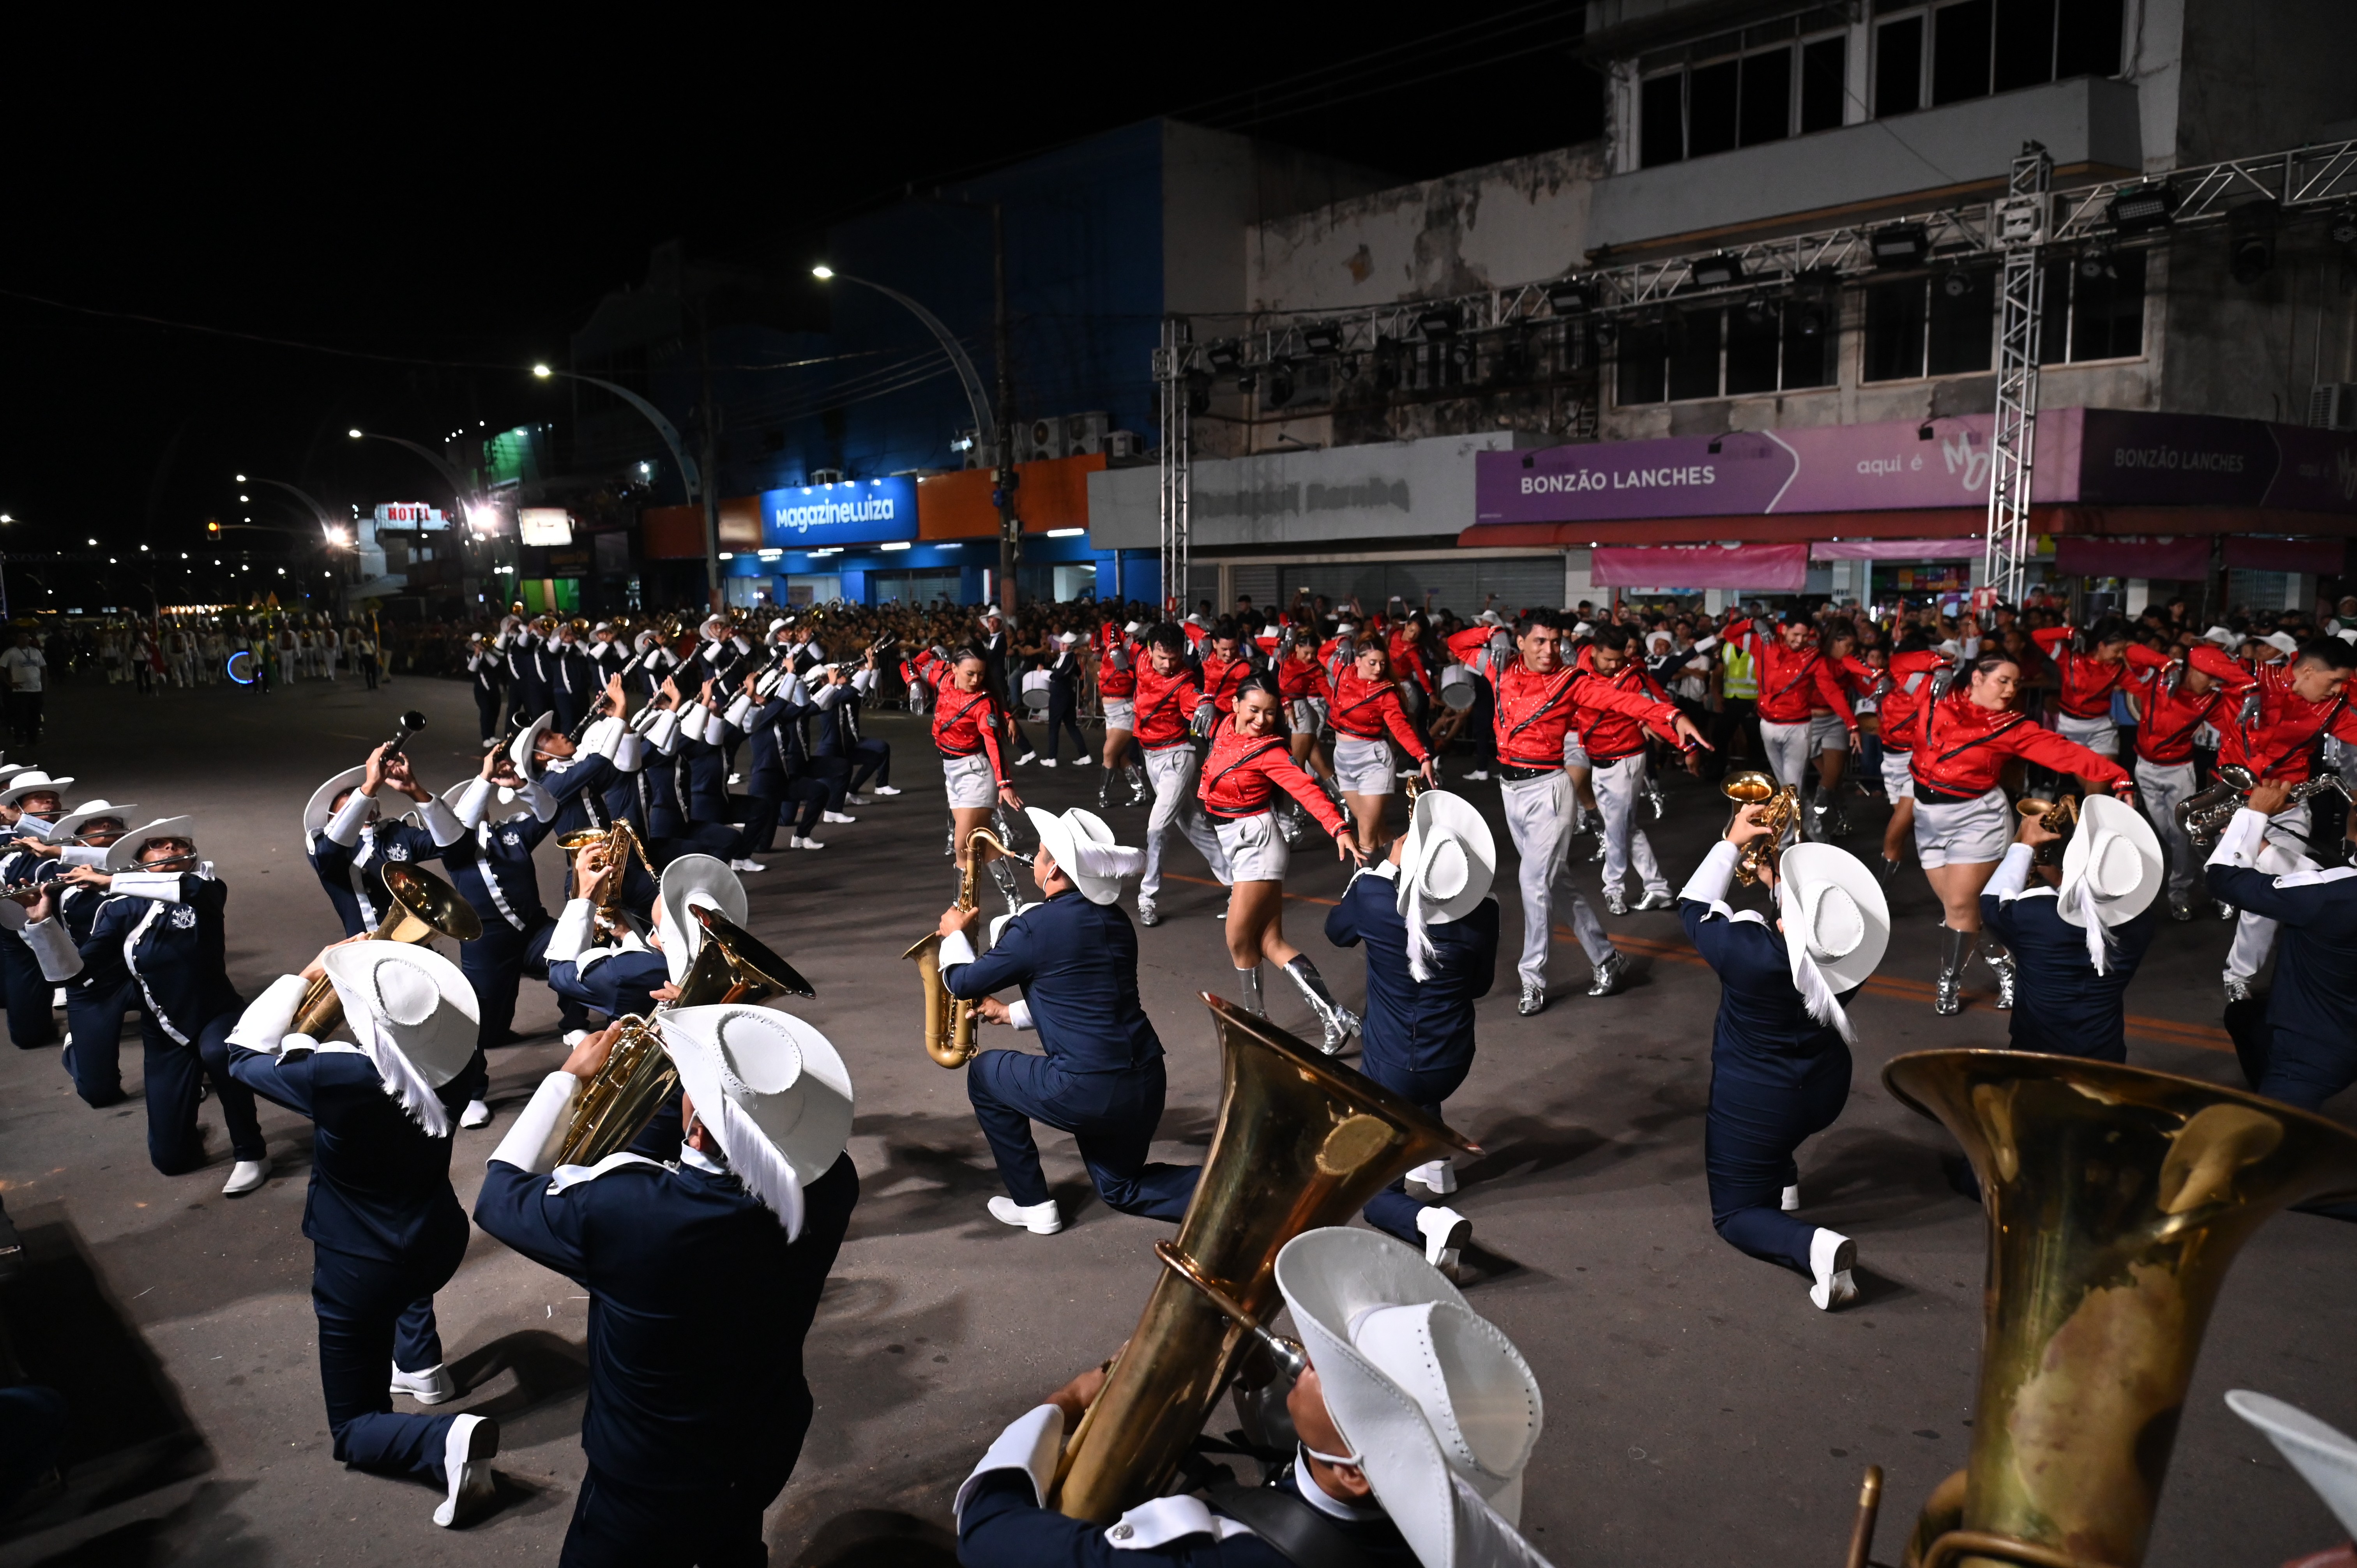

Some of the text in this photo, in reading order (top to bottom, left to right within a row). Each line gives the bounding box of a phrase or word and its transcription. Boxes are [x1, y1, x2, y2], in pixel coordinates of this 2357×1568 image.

[1857, 454, 1902, 477] aqui
[1910, 453, 1923, 471] é
[2115, 445, 2244, 473] BONZÃO LANCHES
[1521, 466, 1716, 494] BONZÃO LANCHES
